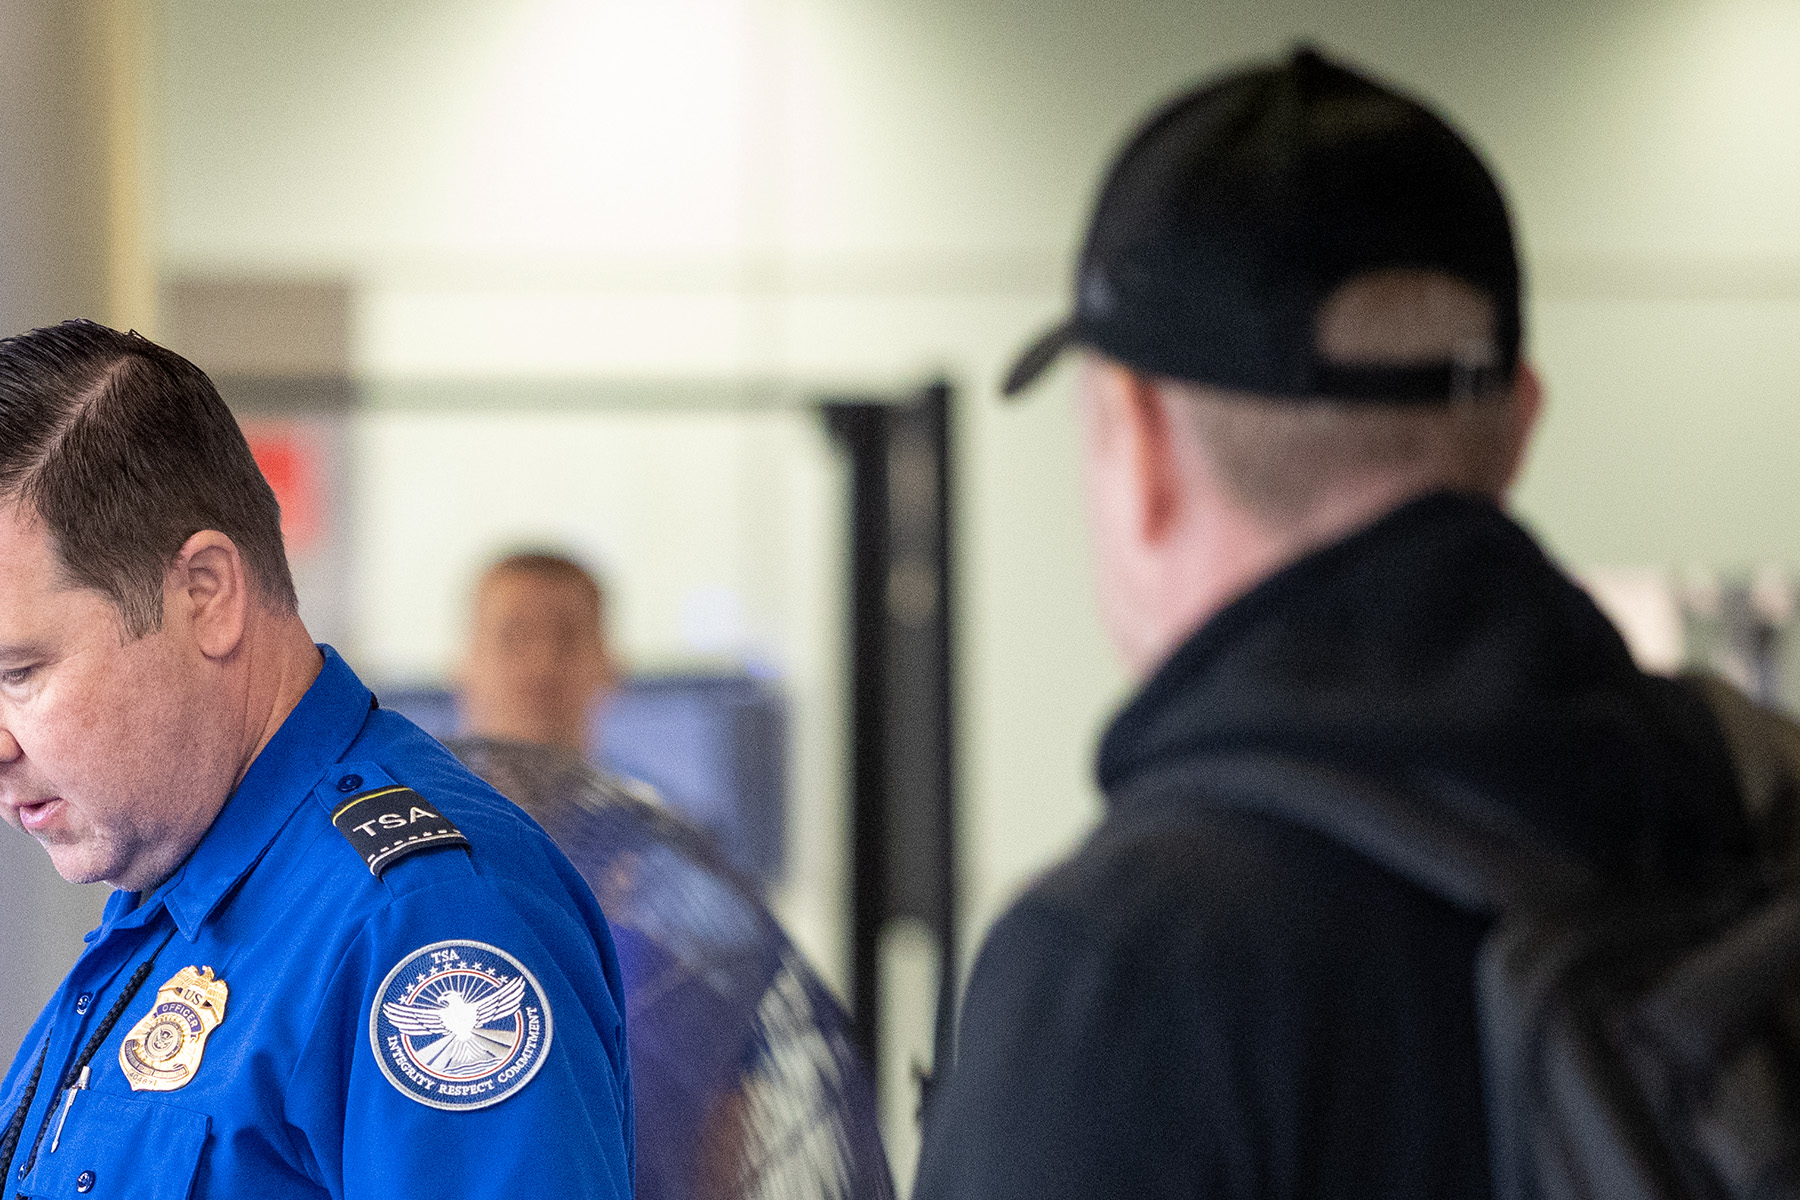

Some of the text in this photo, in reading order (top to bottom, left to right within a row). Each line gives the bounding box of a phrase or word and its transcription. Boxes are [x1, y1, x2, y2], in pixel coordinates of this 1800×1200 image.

[352, 806, 439, 837] TSA
[431, 949, 460, 964] TSA
[183, 988, 203, 1005] US
[162, 1003, 198, 1028] OFFICER
[387, 1006, 540, 1096] INTEGRITY RESPECT COMMITMENT
